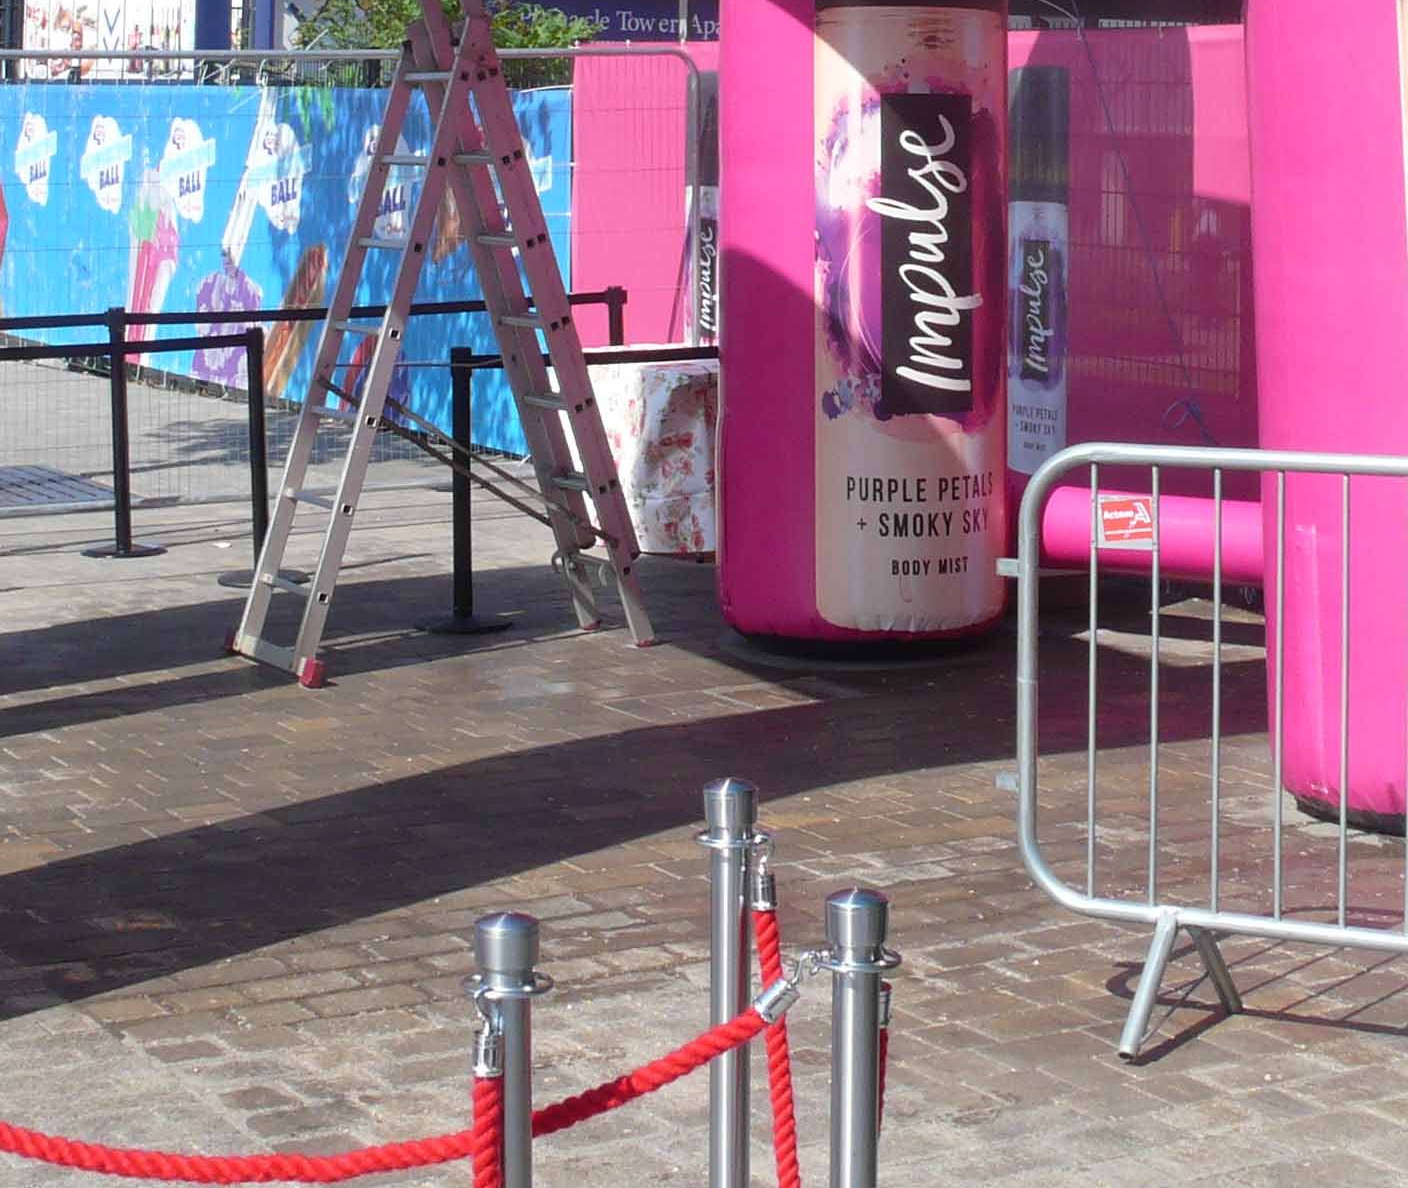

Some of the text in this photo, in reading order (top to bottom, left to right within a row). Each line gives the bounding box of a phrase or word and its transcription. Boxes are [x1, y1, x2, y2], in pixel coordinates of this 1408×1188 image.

[98, 164, 120, 190] BALL
[178, 170, 201, 197] BALL
[270, 177, 298, 206] BALL
[377, 185, 406, 214] ALL
[865, 113, 984, 392] Impulse
[1019, 247, 1055, 373] Impulse
[846, 471, 993, 503] PURPLE PETALS
[878, 511, 953, 538] SMOKY
[962, 508, 989, 534] SKY
[891, 556, 969, 576] BODY MIST
